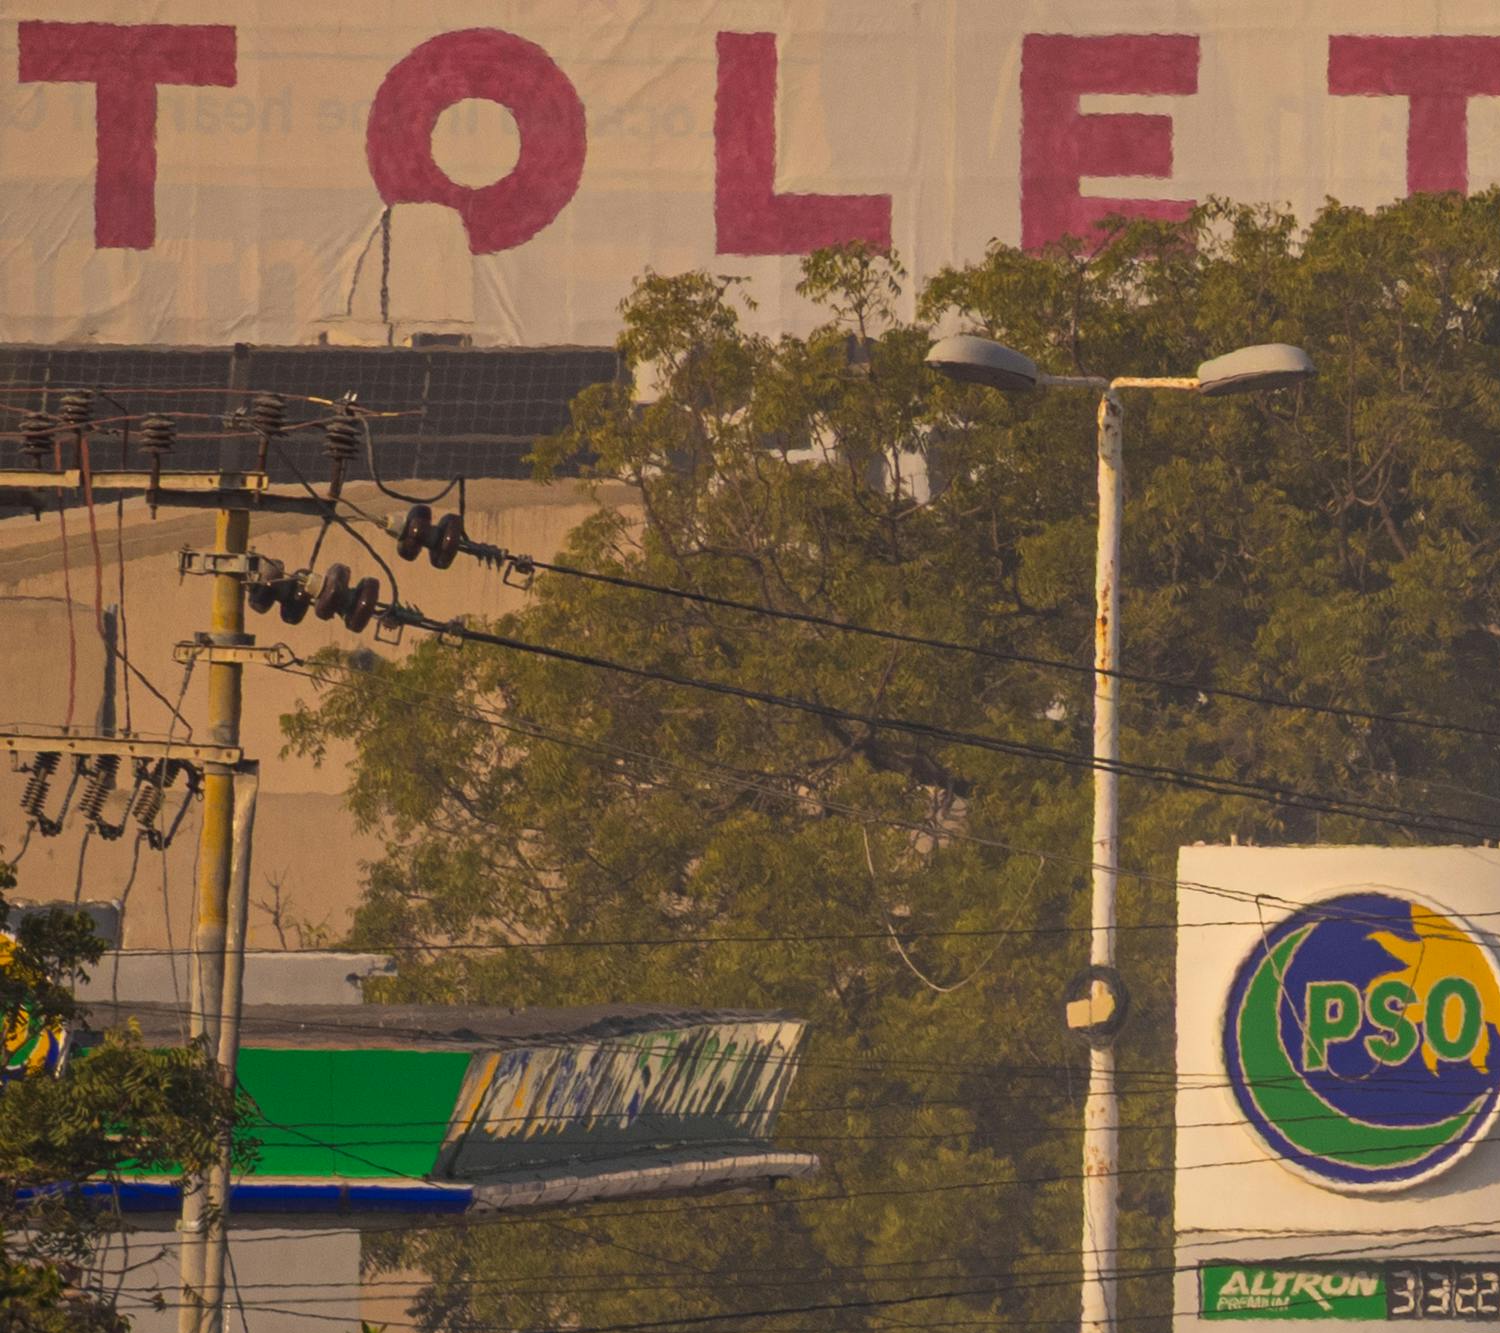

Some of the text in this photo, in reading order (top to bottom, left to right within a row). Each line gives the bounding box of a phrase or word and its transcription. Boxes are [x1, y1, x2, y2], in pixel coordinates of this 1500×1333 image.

[1304, 976, 1486, 1074] PSO
[1217, 1296, 1291, 1312] PREMIUM
[1220, 1270, 1379, 1311] ALTRON
